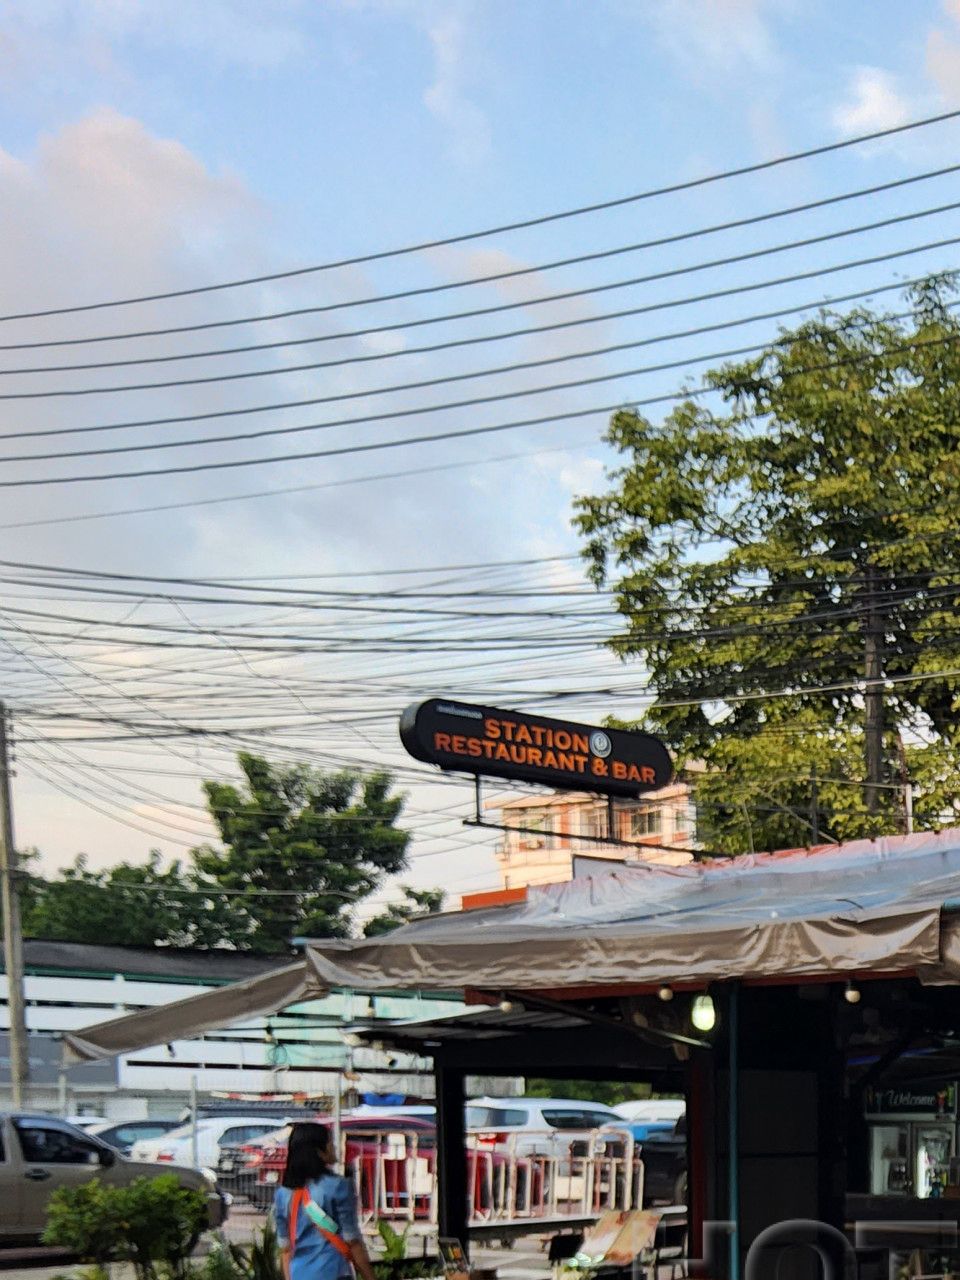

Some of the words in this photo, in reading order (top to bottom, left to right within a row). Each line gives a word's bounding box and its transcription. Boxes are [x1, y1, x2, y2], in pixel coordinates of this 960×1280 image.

[434, 732, 588, 773] RESTAURANT
[591, 757, 608, 777] &
[613, 761, 656, 785] BAR
[485, 719, 589, 754] STATION
